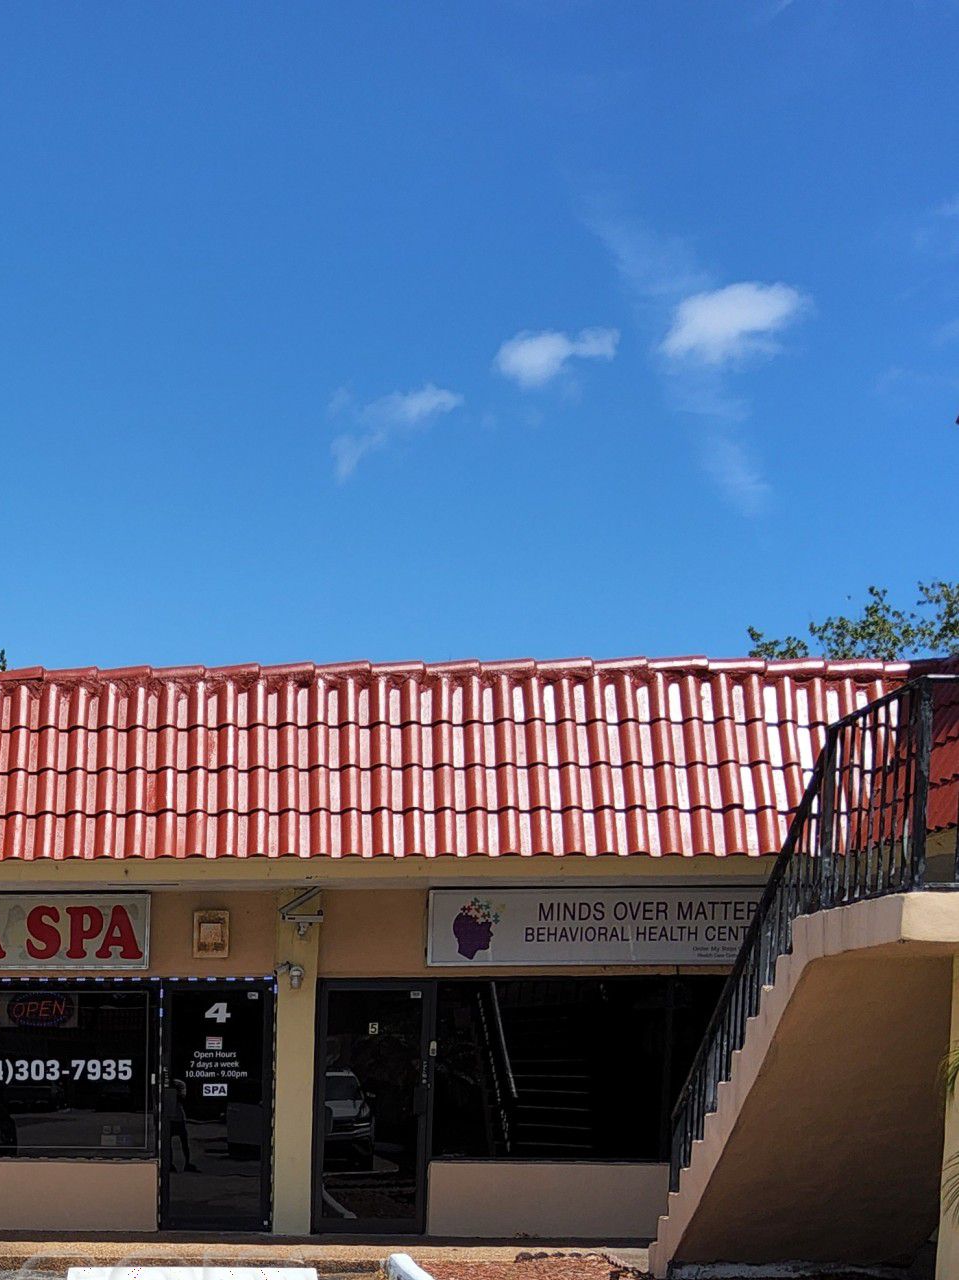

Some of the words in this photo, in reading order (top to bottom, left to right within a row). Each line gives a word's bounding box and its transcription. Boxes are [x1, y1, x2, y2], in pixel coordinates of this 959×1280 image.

[538, 902, 606, 921] MINDS
[613, 902, 668, 921] OVER
[26, 904, 143, 960] SPA
[524, 926, 630, 943] BEHAVIORAL
[635, 926, 699, 942] HEALTH
[12, 1001, 66, 1020] OPEN
[204, 1002, 231, 1023] 4
[370, 1024, 377, 1033] 5
[193, 1051, 214, 1060] Open
[215, 1051, 237, 1059] Hours
[196, 1060, 213, 1070] days
[220, 1060, 239, 1068] week
[204, 1085, 227, 1095] SPA
